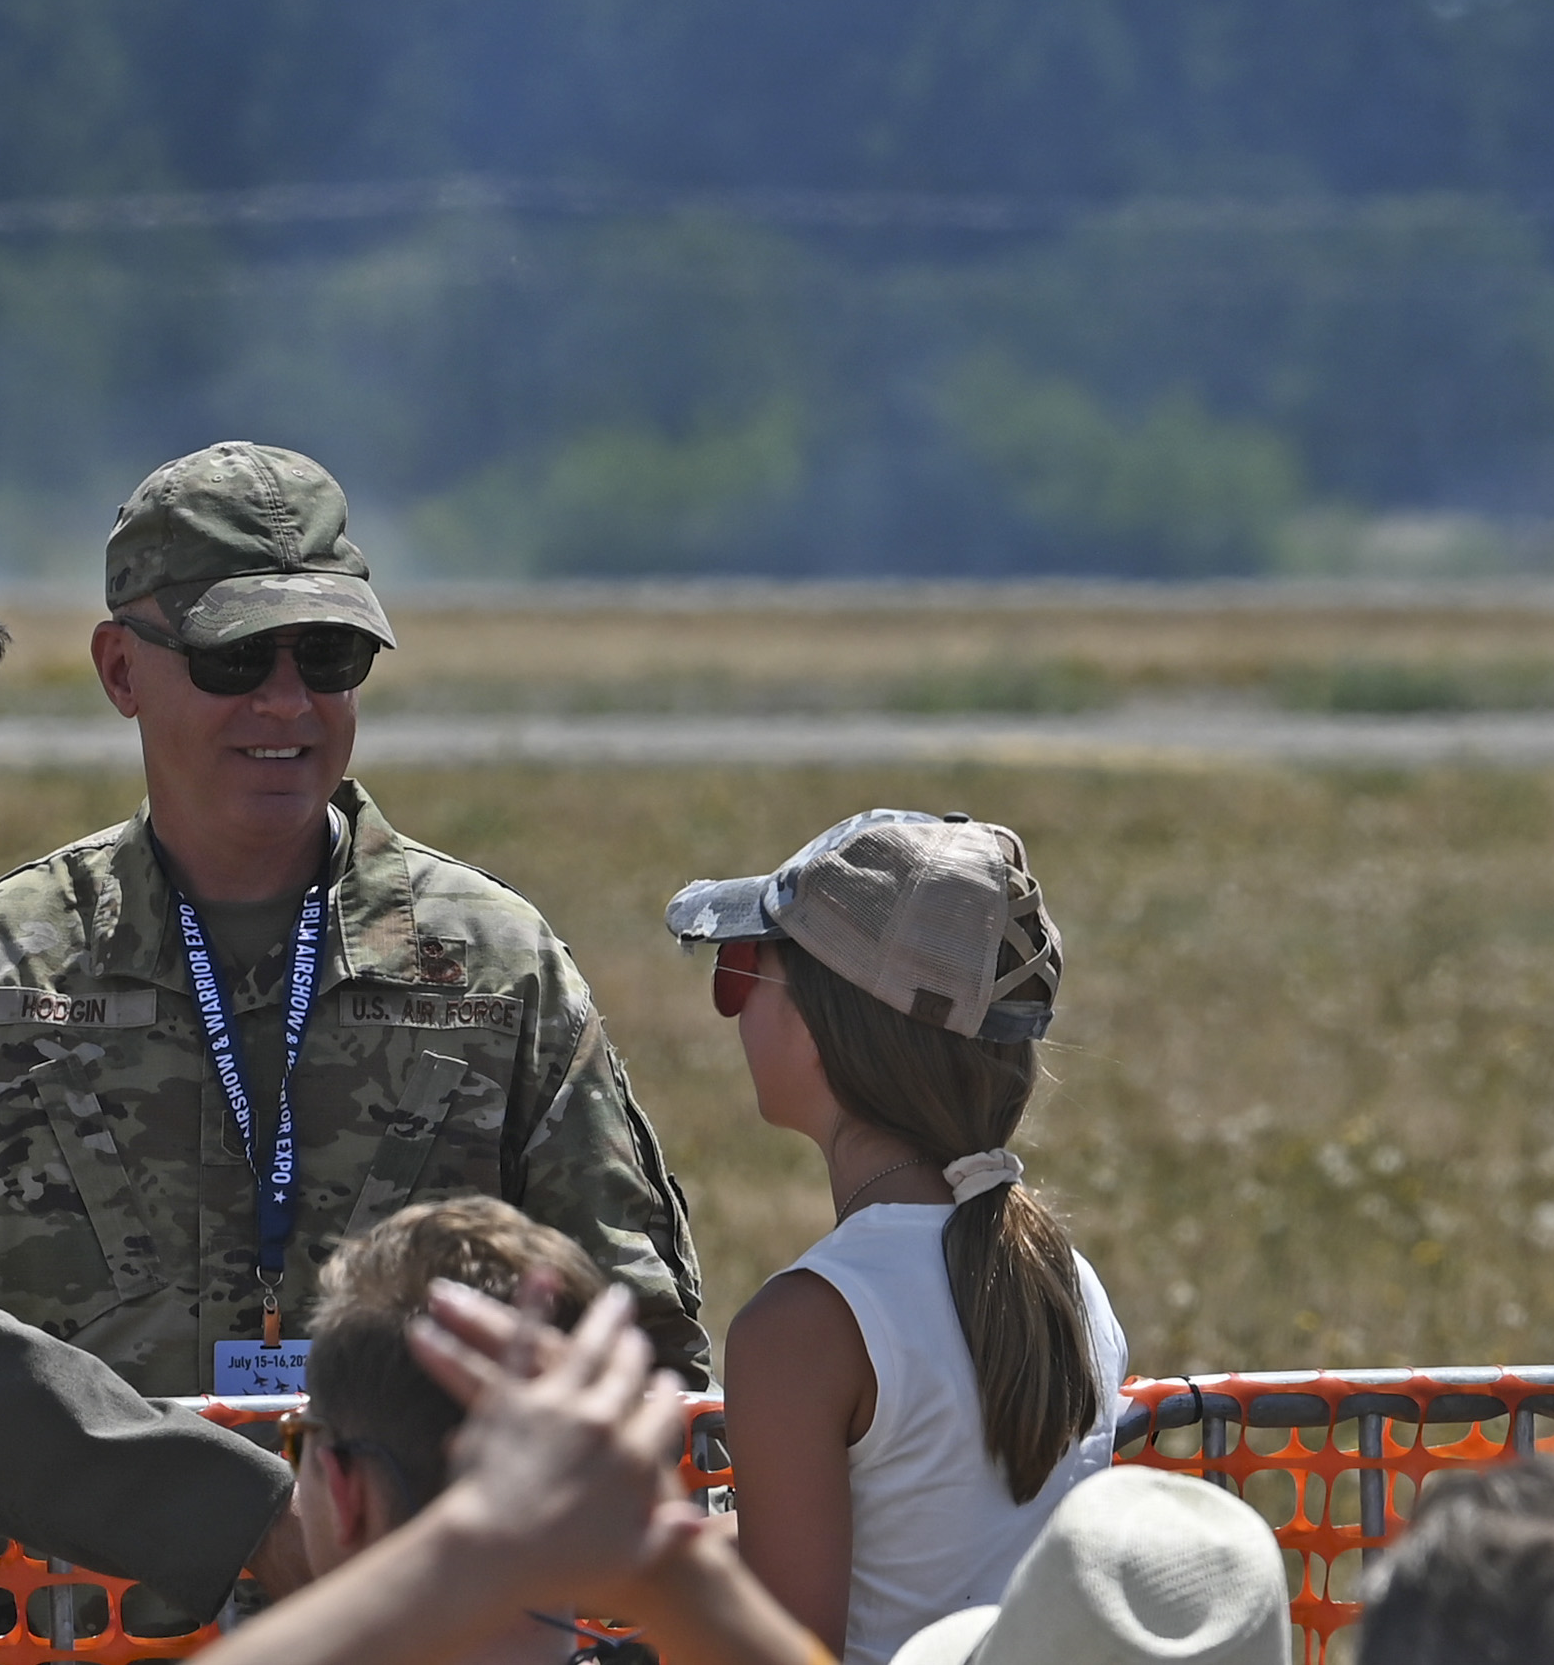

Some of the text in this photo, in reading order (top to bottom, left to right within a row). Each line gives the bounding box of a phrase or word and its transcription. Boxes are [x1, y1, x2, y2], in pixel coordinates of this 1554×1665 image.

[178, 903, 205, 946] EXPO
[298, 900, 321, 941] JBLM
[188, 949, 226, 1036] WARRIOR
[286, 943, 317, 1032] AIRSHOW
[21, 994, 107, 1024] HODGIN
[352, 995, 517, 1029] U.S. AIR FORCE
[211, 1033, 231, 1051] &
[285, 1031, 299, 1045] &
[271, 1137, 293, 1185] EXPO
[228, 1356, 252, 1371] July
